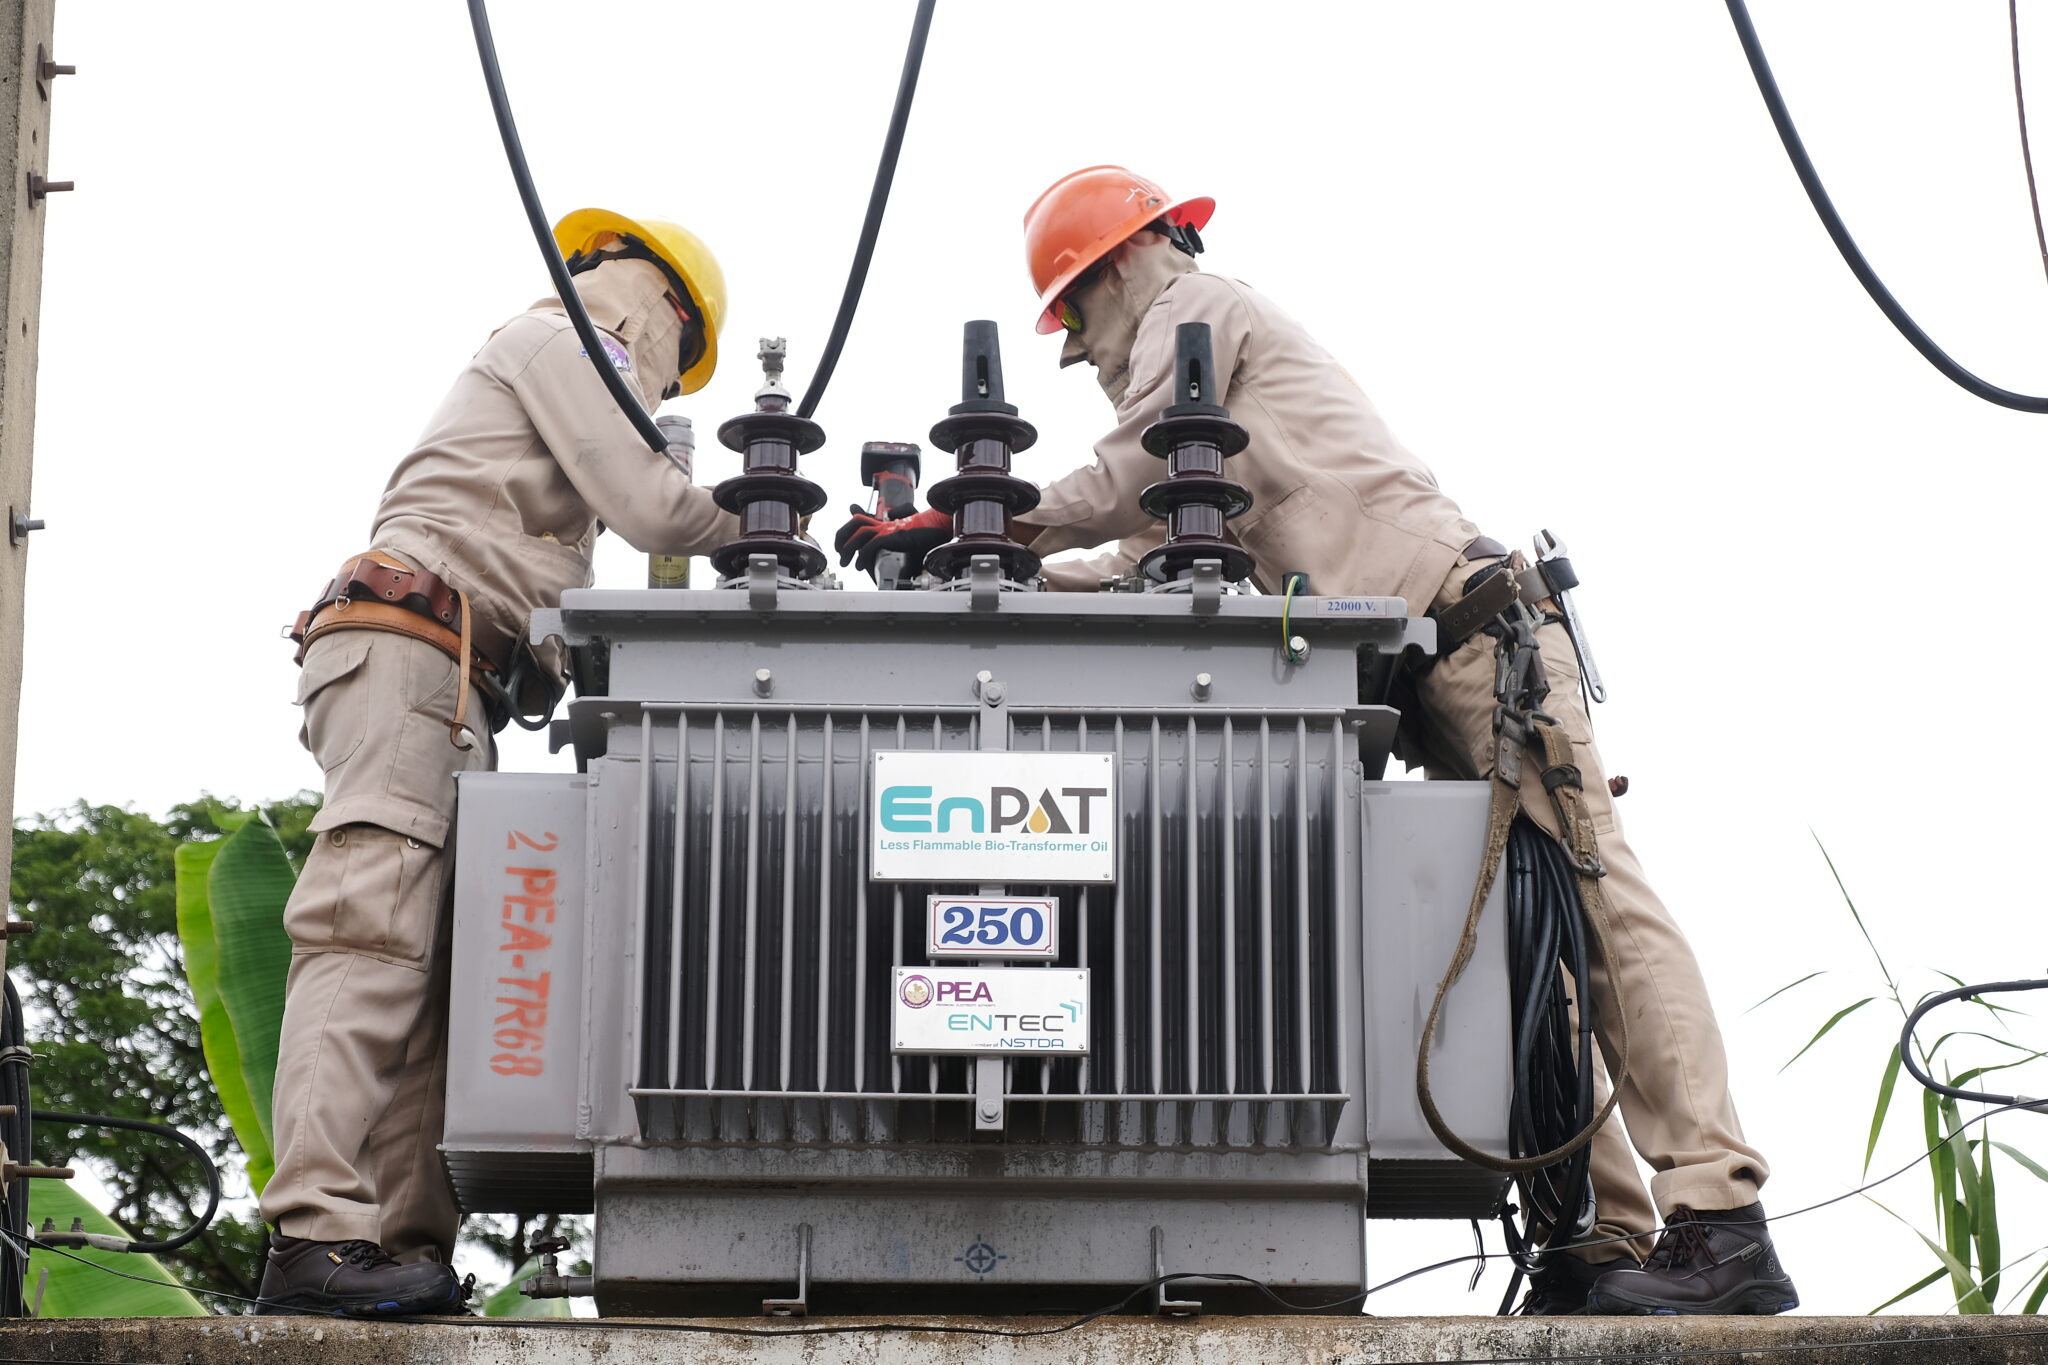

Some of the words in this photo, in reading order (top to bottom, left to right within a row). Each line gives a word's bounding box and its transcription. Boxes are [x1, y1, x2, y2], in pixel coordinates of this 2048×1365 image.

[1327, 601, 1361, 612] 22000
[1365, 601, 1376, 612] V.
[880, 785, 1107, 834] EnPAT
[507, 830, 559, 851] 2
[880, 839, 910, 850] Less
[913, 839, 982, 851] Flammable
[985, 840, 1087, 852] Bio-Transformer
[1090, 841, 1108, 852] Oil
[941, 906, 1043, 945] 250
[489, 866, 557, 1077] PEA-TR68
[936, 981, 993, 1002] PEA
[948, 1014, 1064, 1032] ENTEC
[1000, 1038, 1064, 1048] NSTDA
